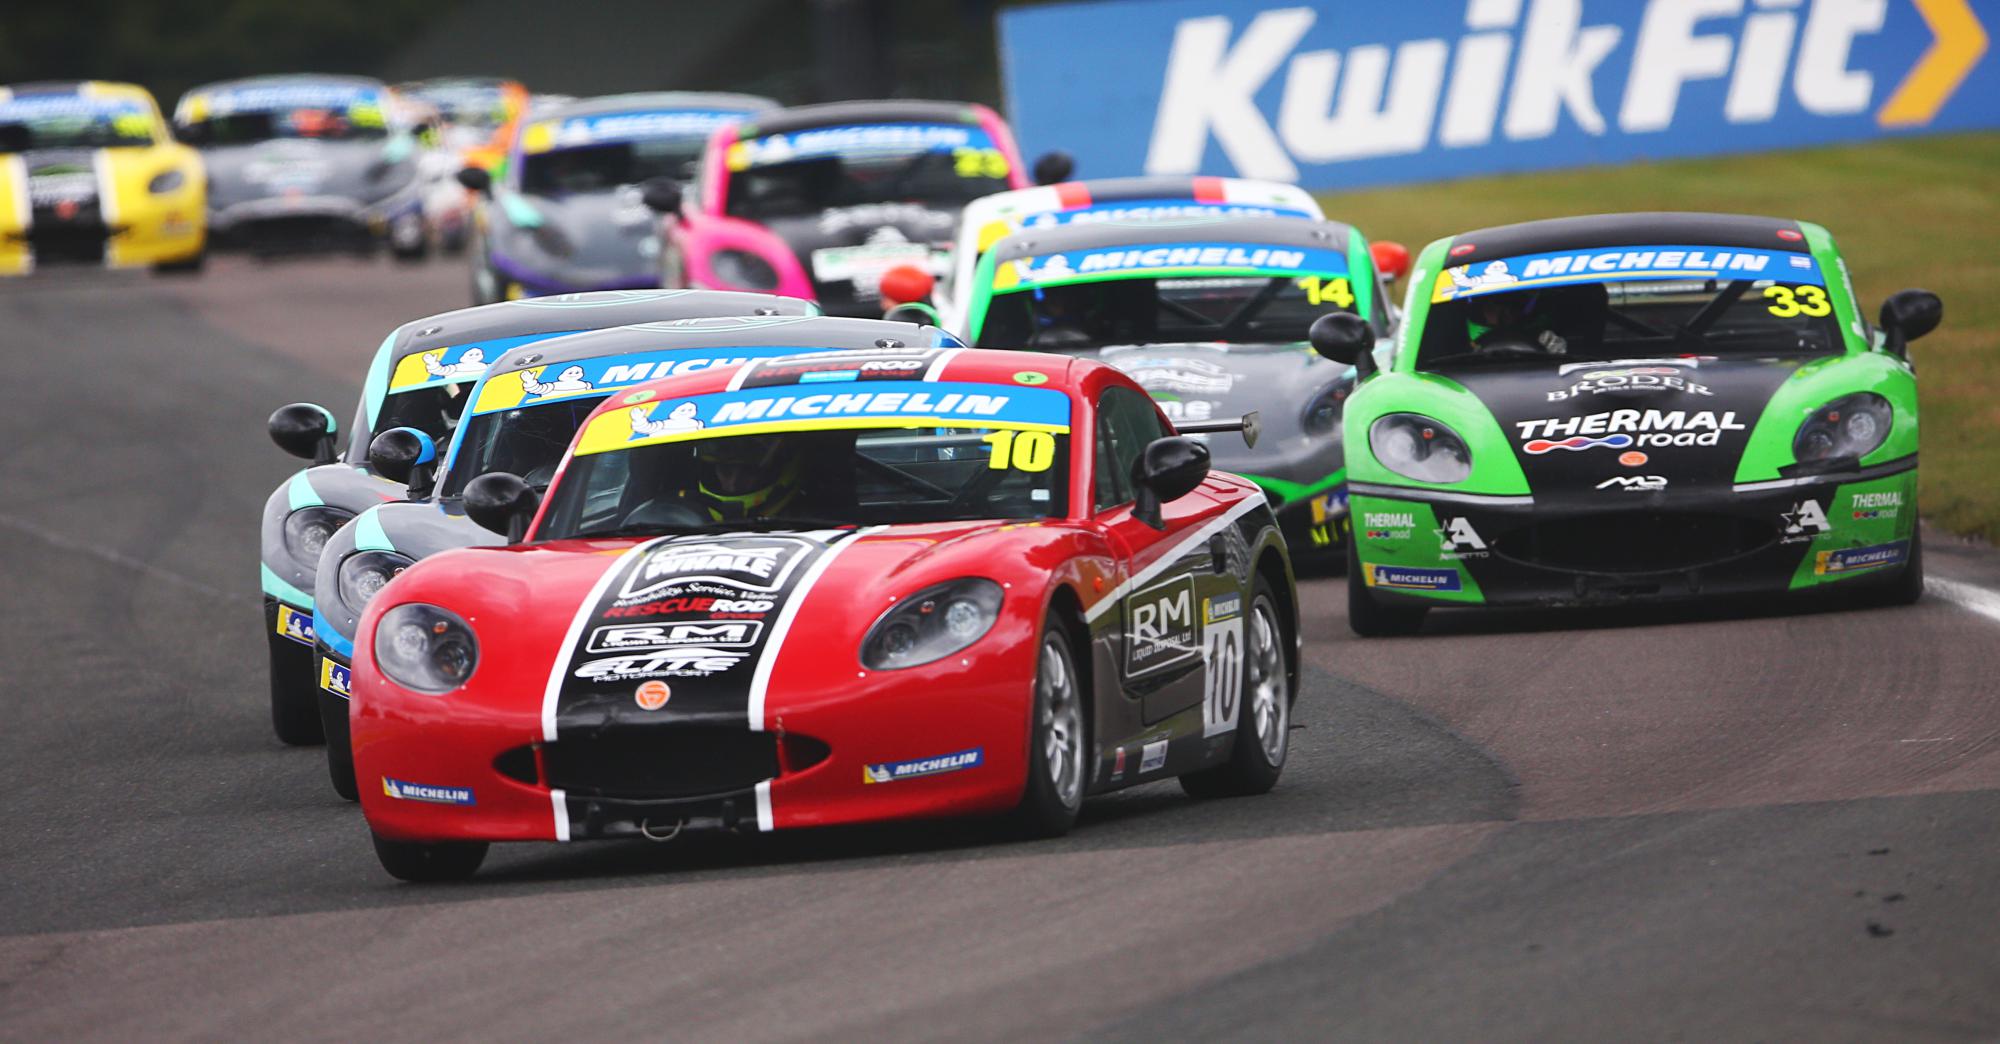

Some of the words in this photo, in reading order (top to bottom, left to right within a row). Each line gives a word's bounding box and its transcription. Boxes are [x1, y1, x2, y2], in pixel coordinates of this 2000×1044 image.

[1079, 247, 1305, 271] MICHELIN
[1523, 249, 1770, 278] MICHELIN
[1299, 276, 1354, 308] 14
[1763, 285, 1832, 318] 33
[1547, 375, 1714, 401] BRODER
[711, 393, 1009, 423] MICHELIN
[1516, 409, 1746, 439] THERMAL
[982, 429, 1056, 472] 10
[1637, 429, 1721, 447] road
[1853, 491, 1904, 508] THERMAL
[1364, 512, 1416, 528] THERMAL
[645, 554, 778, 580] WHALE
[1390, 572, 1448, 585] MICHELIN
[1133, 588, 1191, 646] RM
[604, 624, 748, 643] RM
[575, 656, 741, 678] ELITE
[1210, 630, 1237, 724] 10
[895, 751, 978, 775] MICHELIN
[402, 783, 469, 801] MICHELIN
